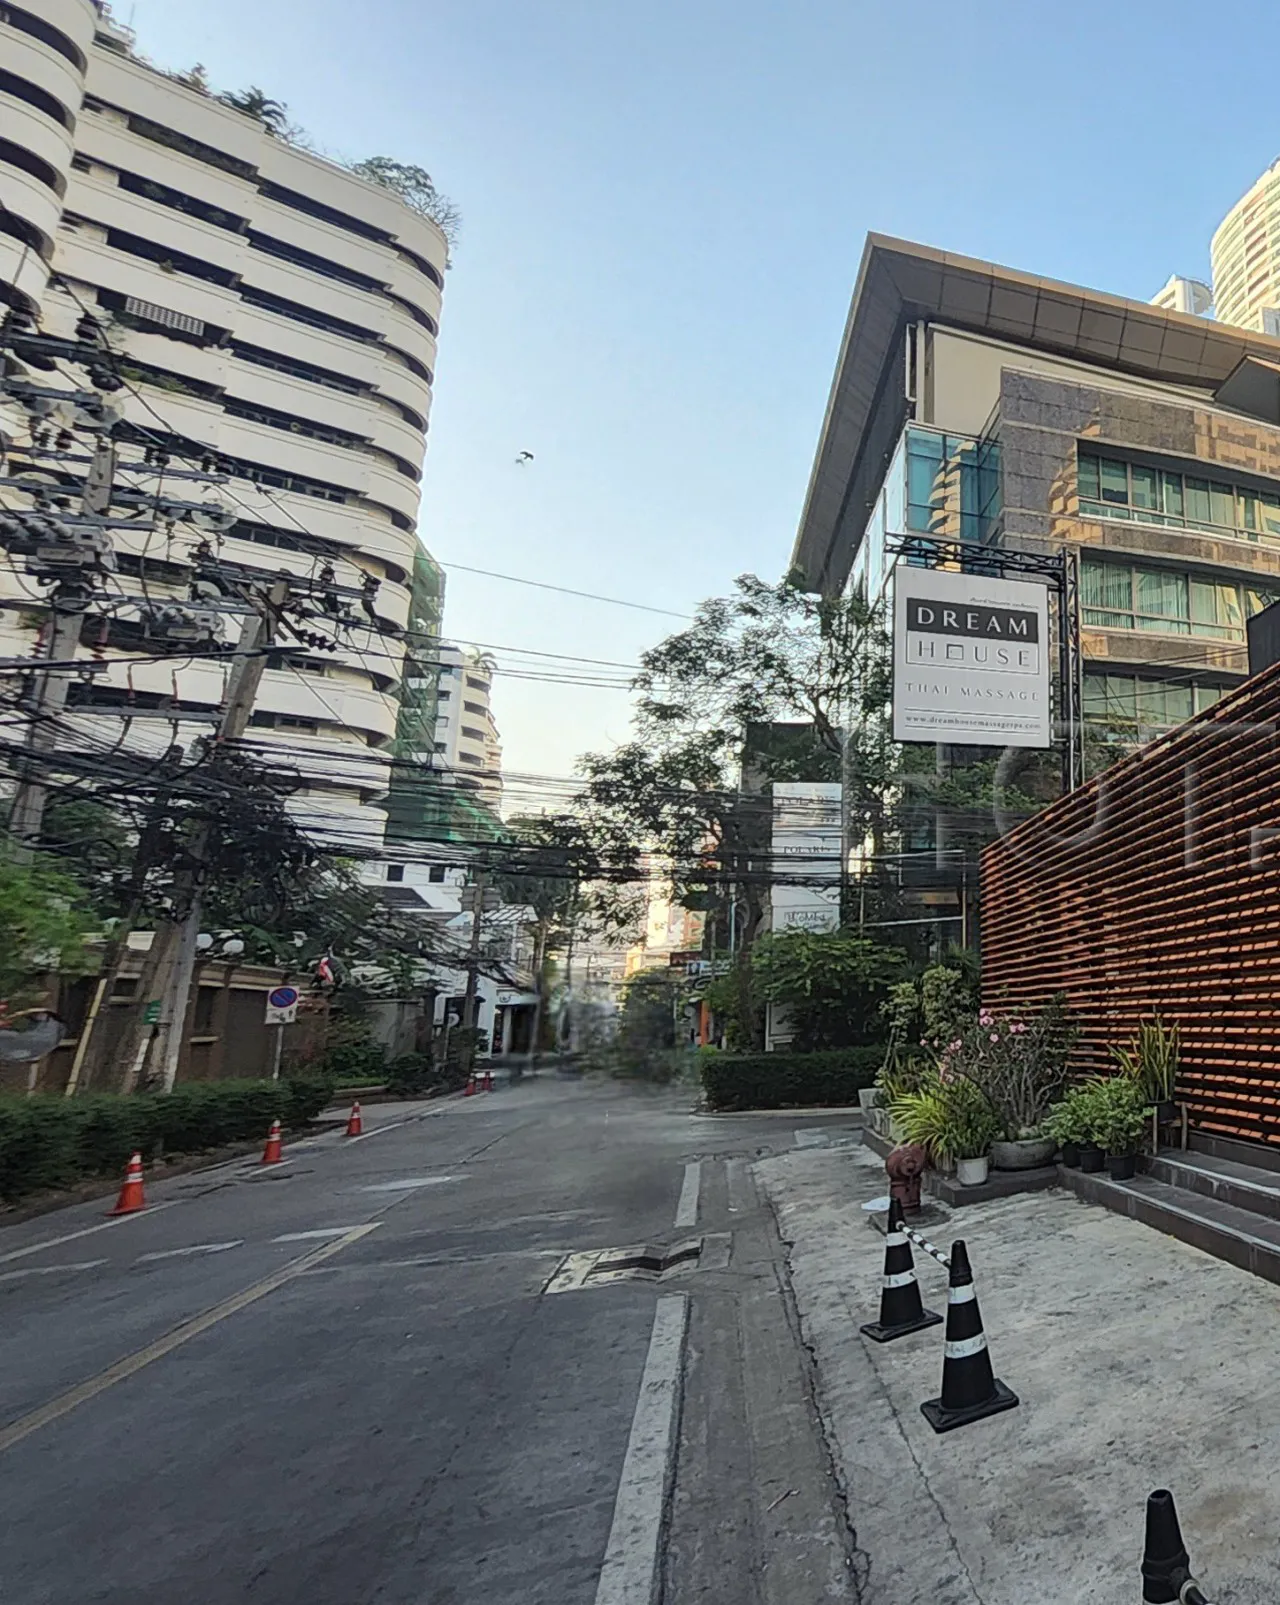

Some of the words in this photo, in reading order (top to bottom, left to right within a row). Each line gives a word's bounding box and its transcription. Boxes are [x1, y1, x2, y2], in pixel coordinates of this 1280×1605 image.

[917, 606, 1028, 635] DREAM
[905, 682, 949, 695] THAI
[960, 687, 1039, 701] MASSAGE
